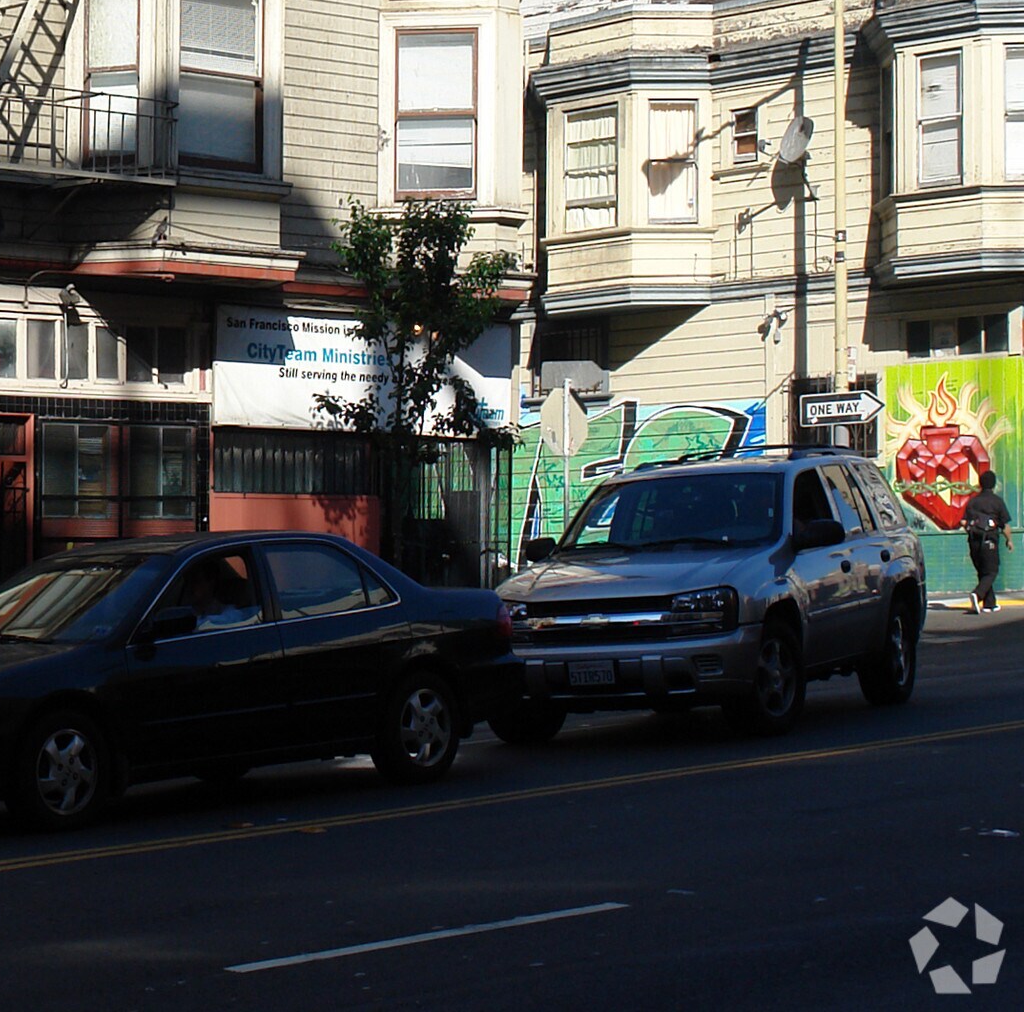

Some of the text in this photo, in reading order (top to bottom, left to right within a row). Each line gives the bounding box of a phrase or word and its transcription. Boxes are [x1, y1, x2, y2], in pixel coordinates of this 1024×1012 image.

[227, 316, 247, 329] San
[249, 318, 299, 332] Francisco
[302, 322, 340, 335] Mission
[247, 343, 317, 363] CityTeam
[279, 367, 298, 379] Still
[301, 369, 338, 384] serving
[340, 370, 357, 382] the
[359, 373, 389, 385] needy
[810, 402, 860, 416] ONE WAY
